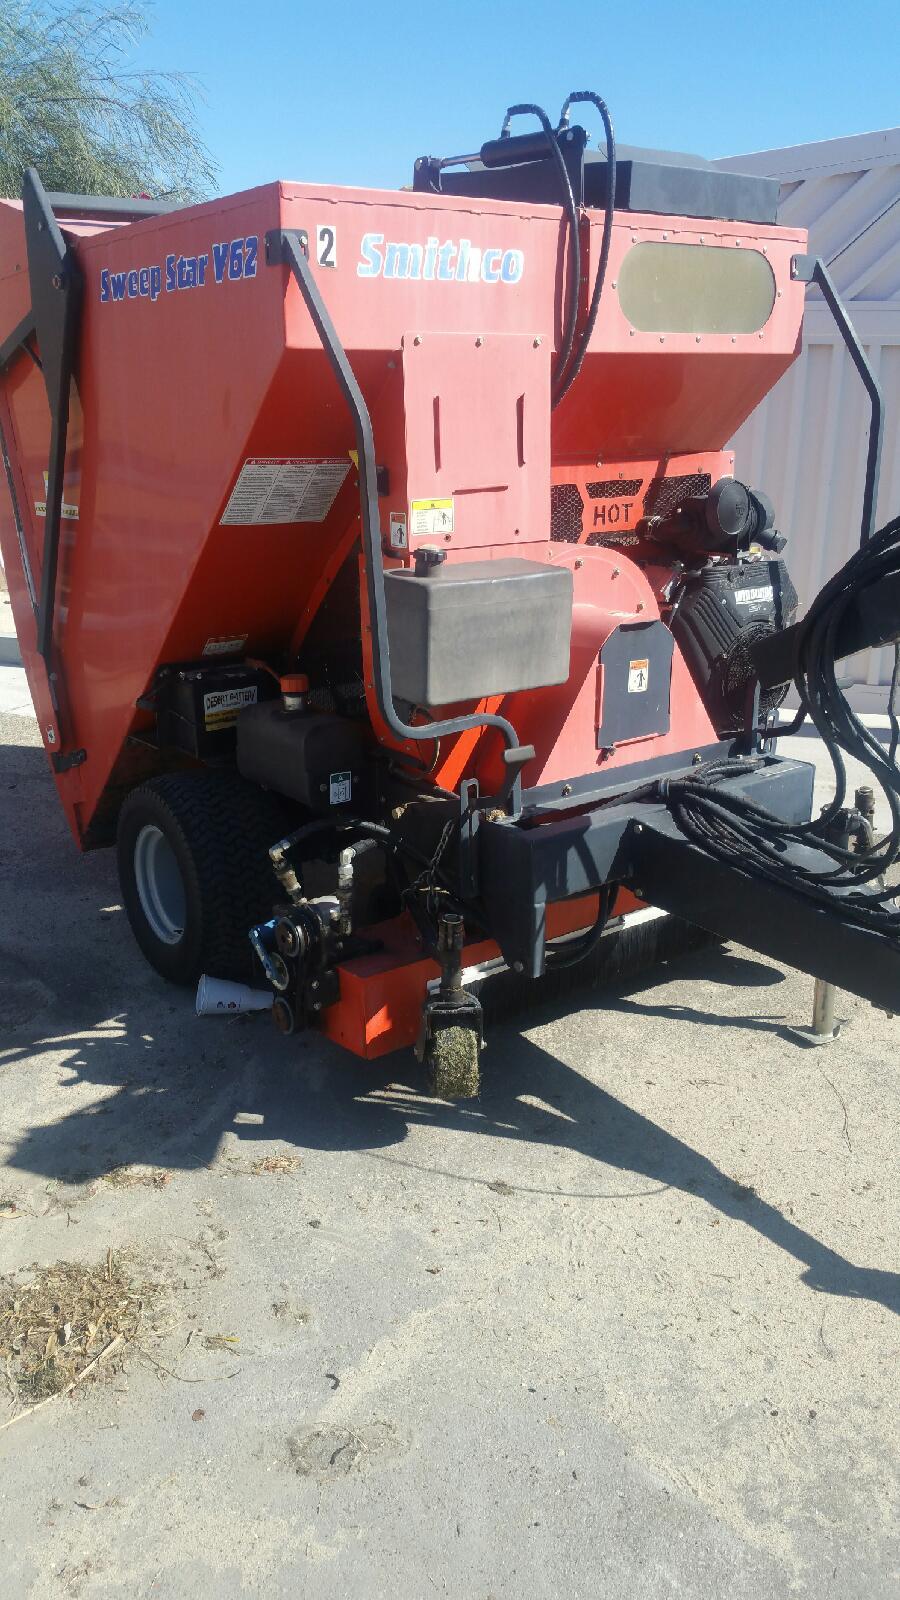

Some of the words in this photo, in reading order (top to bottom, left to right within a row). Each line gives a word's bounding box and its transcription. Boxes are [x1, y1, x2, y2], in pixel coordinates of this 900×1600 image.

[319, 228, 335, 267] 2
[357, 233, 524, 284] Smithco
[100, 265, 162, 303] Sweep
[165, 254, 209, 293] Star
[211, 235, 259, 284] V62
[593, 502, 634, 527] HOT
[206, 694, 229, 711] DESERT
